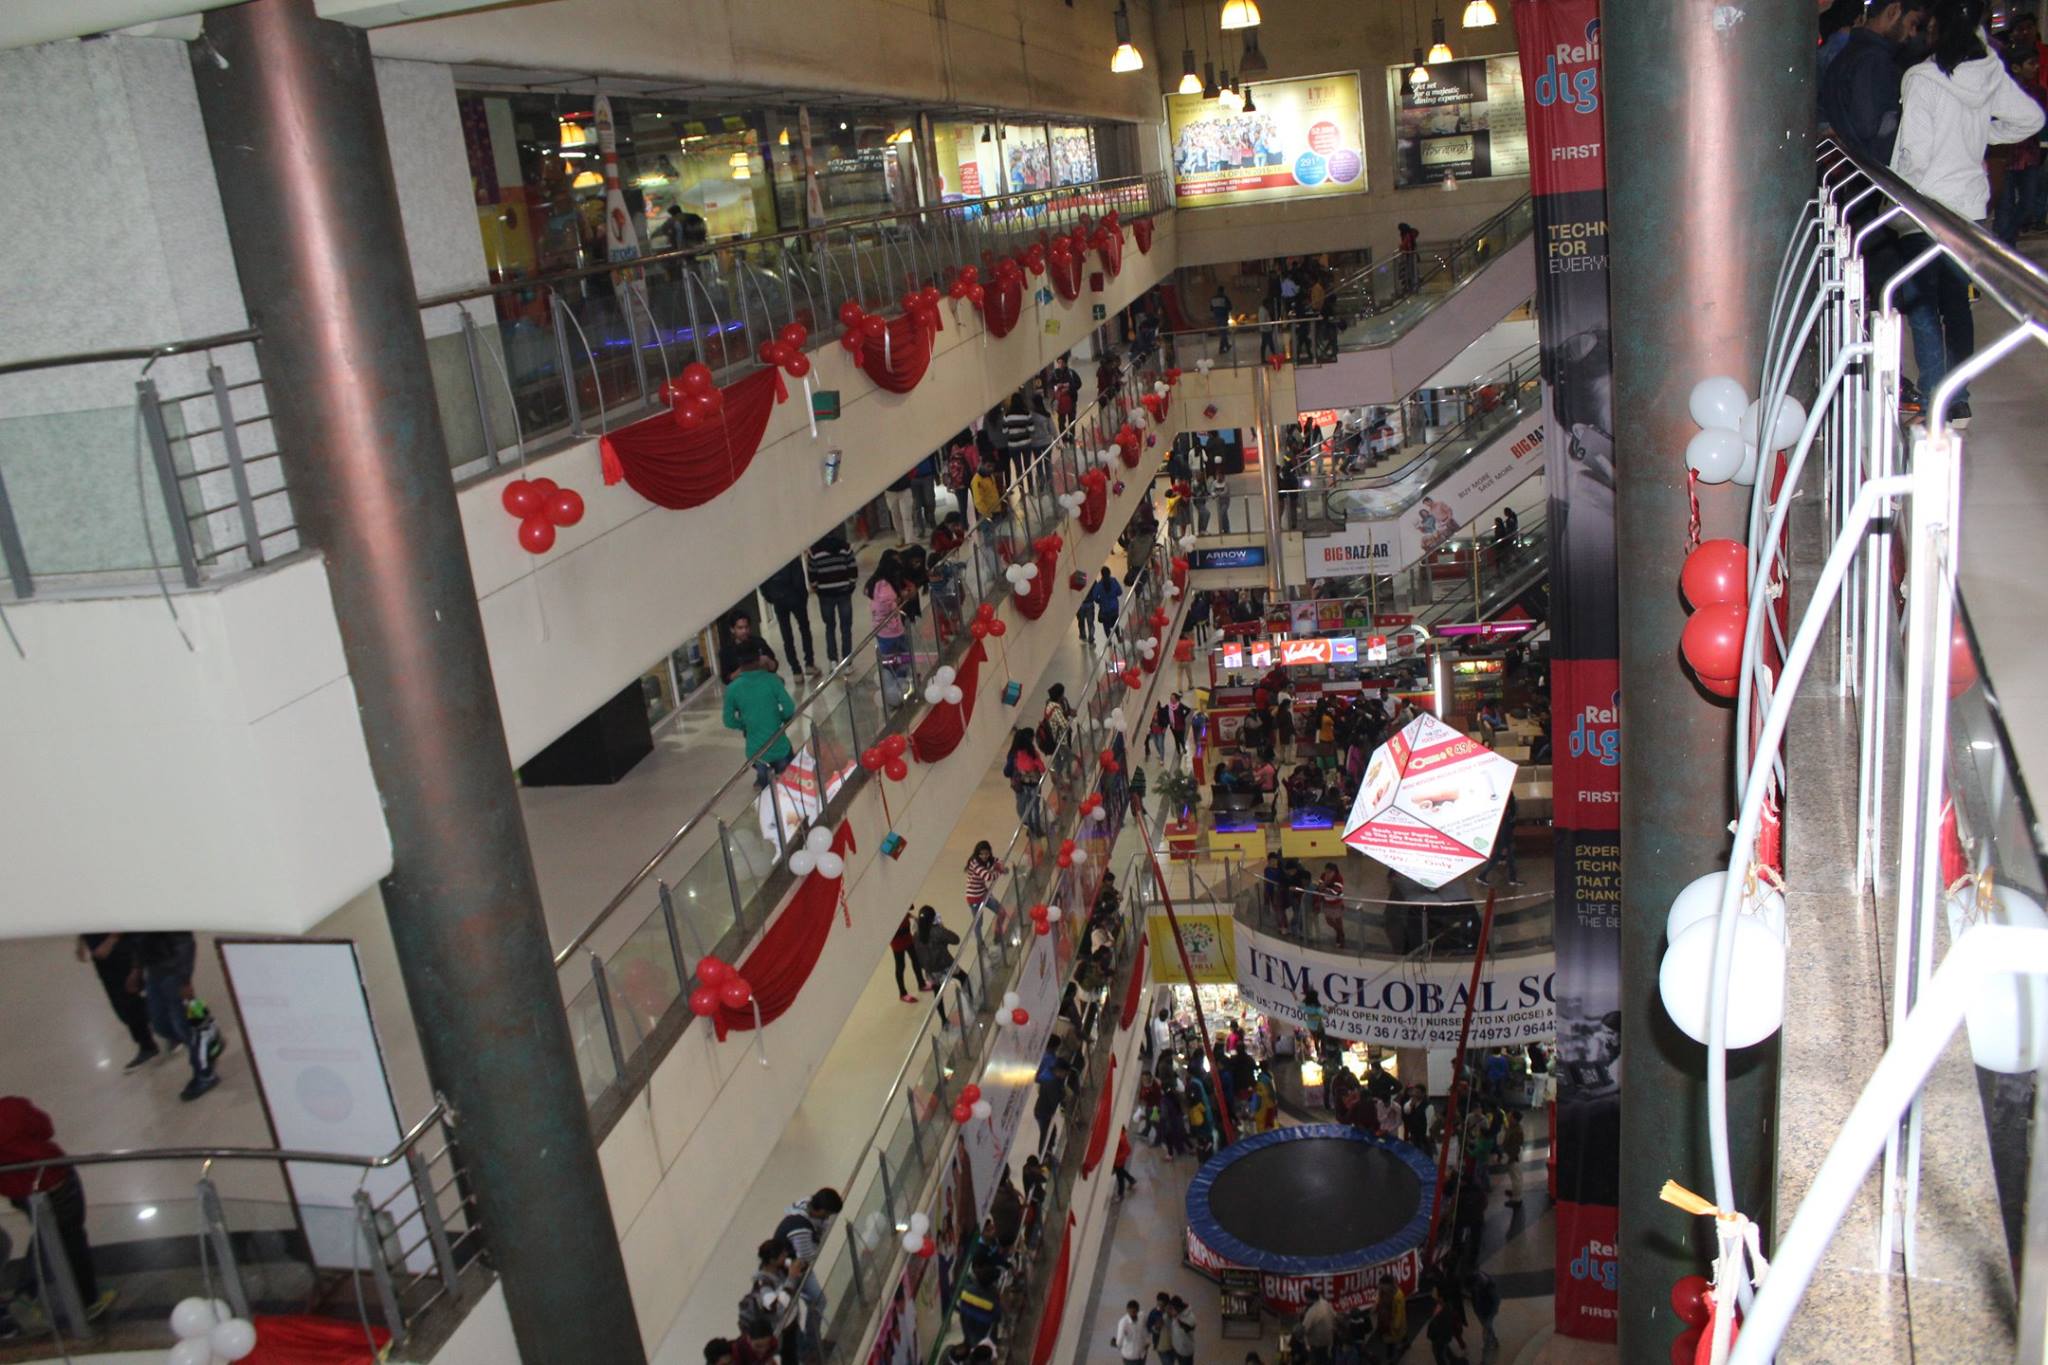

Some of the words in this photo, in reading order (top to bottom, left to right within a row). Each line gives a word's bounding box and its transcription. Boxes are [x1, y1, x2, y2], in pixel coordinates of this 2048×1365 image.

[1551, 143, 1600, 161] FIRST
[1549, 240, 1587, 258] FOR
[1510, 438, 1533, 460] BIG
[1206, 550, 1247, 560] ARROW
[1323, 546, 1344, 562] BIG
[1578, 790, 1620, 802] FIRST
[1576, 875, 1610, 888] THAT
[1577, 902, 1606, 915] LIFE
[1577, 915, 1601, 928] THE
[1248, 946, 1311, 996] ITM
[1323, 972, 1508, 1014] GLOBAL
[1352, 1009, 1379, 1022] OPEN
[1381, 1014, 1417, 1027] 2016-17
[1426, 1017, 1475, 1027] NURSEY
[1480, 1016, 1492, 1025] TO
[1495, 1015, 1505, 1024] IX
[1347, 1022, 1362, 1035] 35
[1374, 1026, 1389, 1039] 36
[1401, 1028, 1417, 1041] 37
[1430, 1026, 1511, 1041] 942574973
